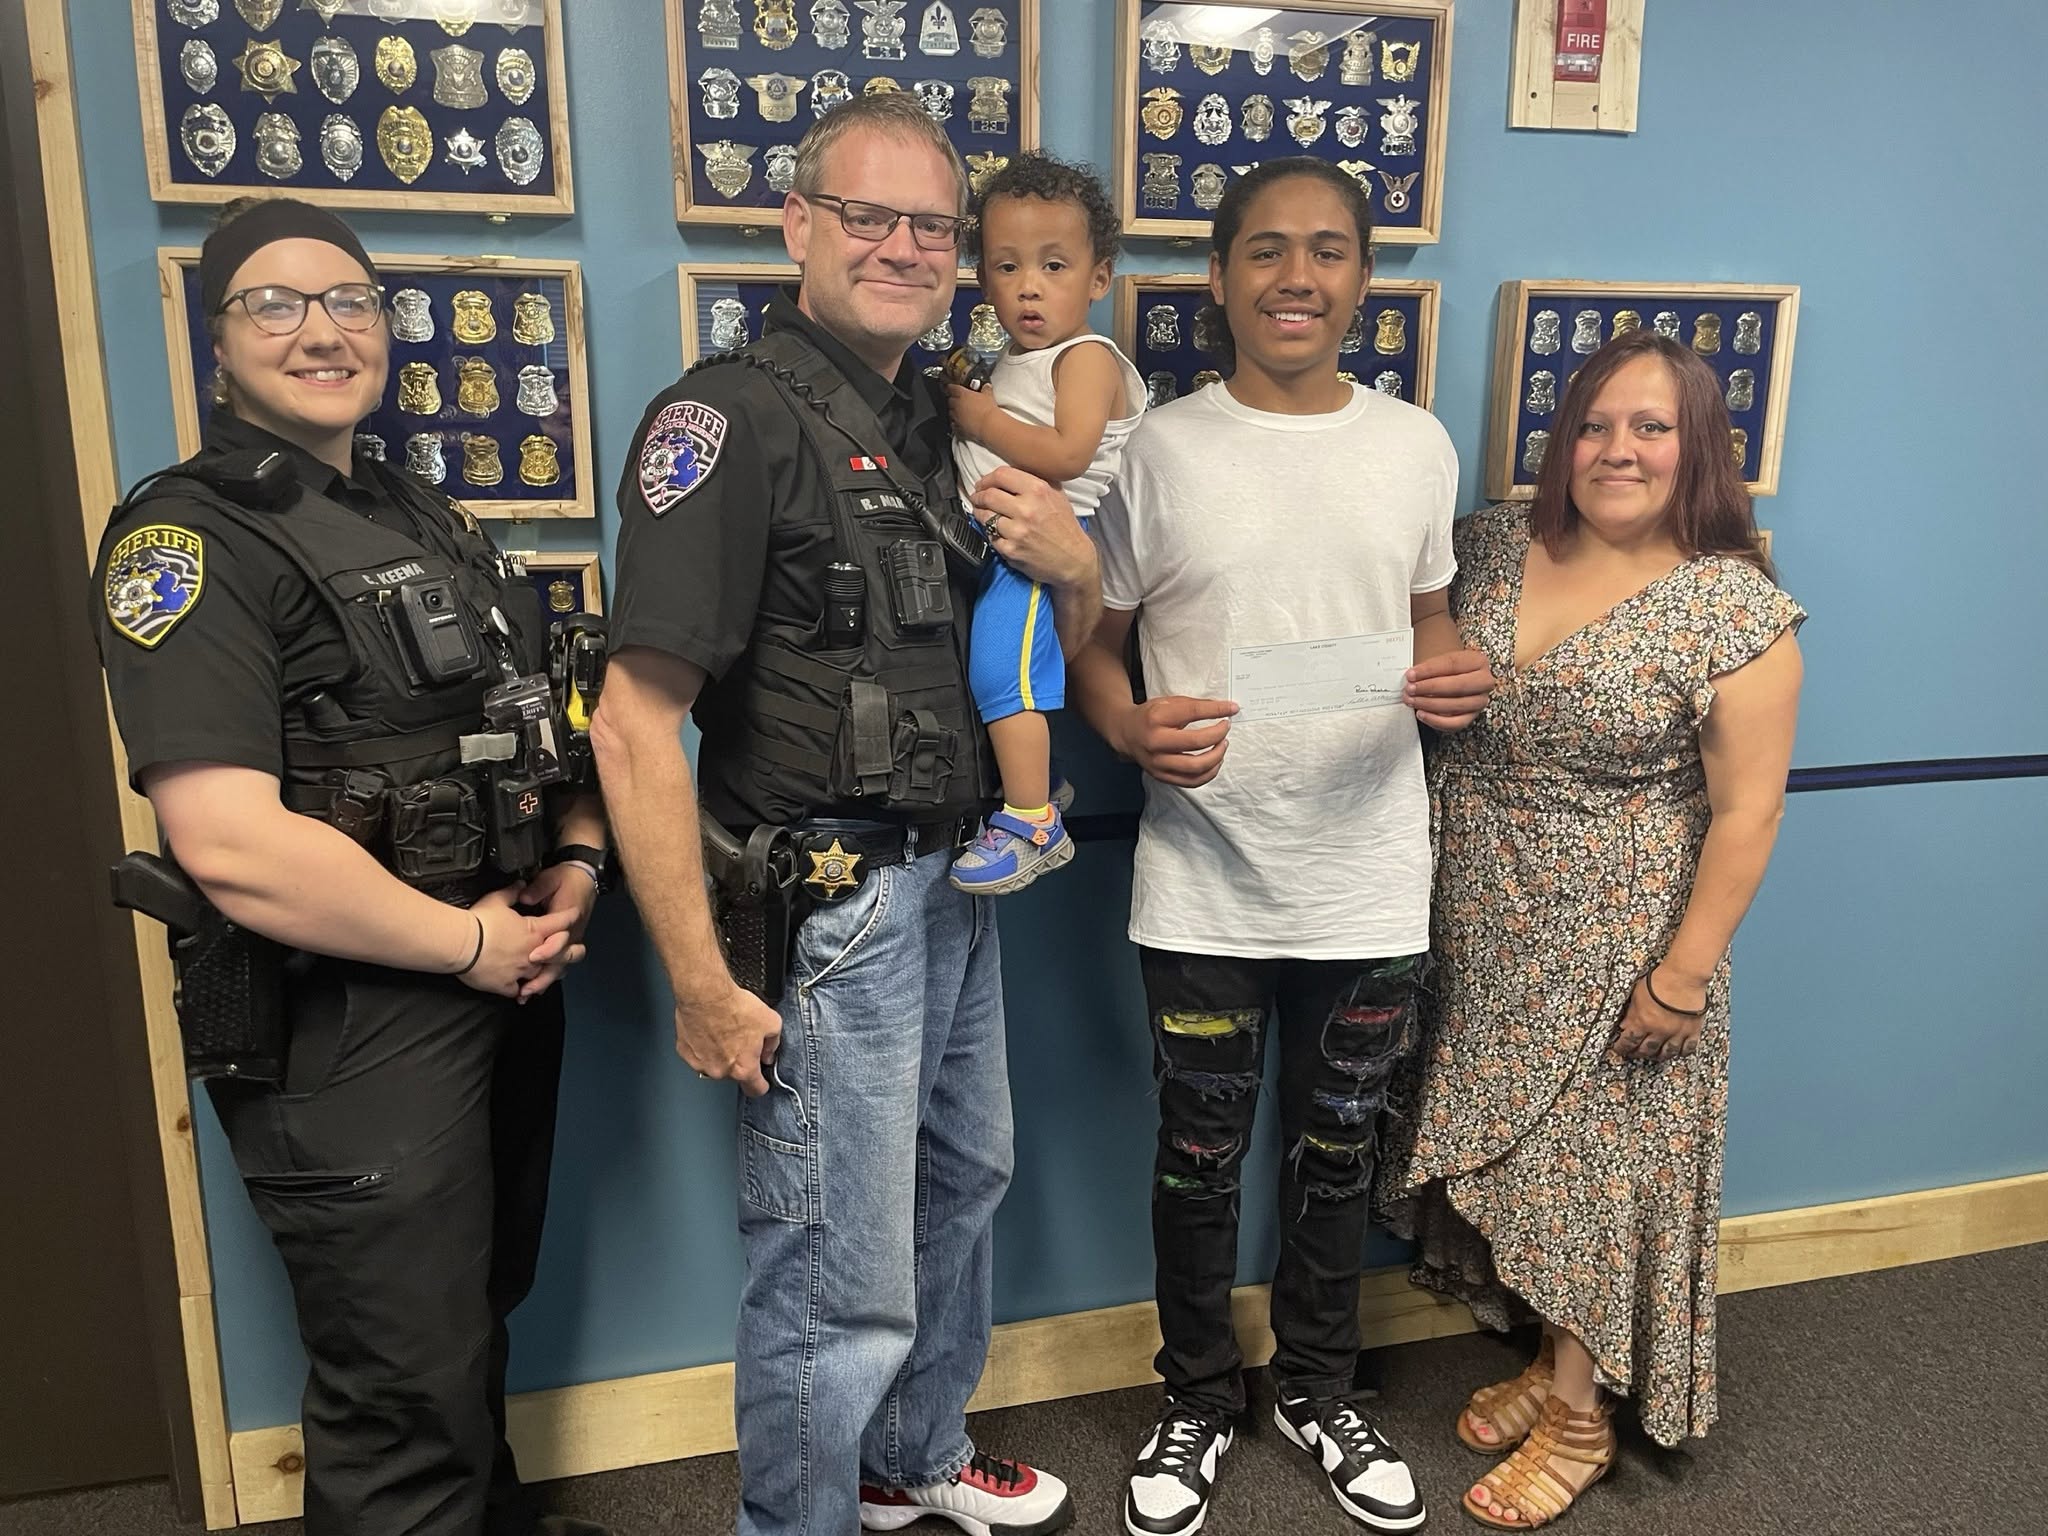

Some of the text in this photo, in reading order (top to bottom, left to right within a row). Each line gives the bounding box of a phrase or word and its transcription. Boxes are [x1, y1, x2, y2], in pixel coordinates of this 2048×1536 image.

[1567, 33, 1601, 49] FIRE
[654, 405, 723, 437] SHERIFF
[860, 498, 879, 511] R.
[377, 563, 425, 585] KEENA
